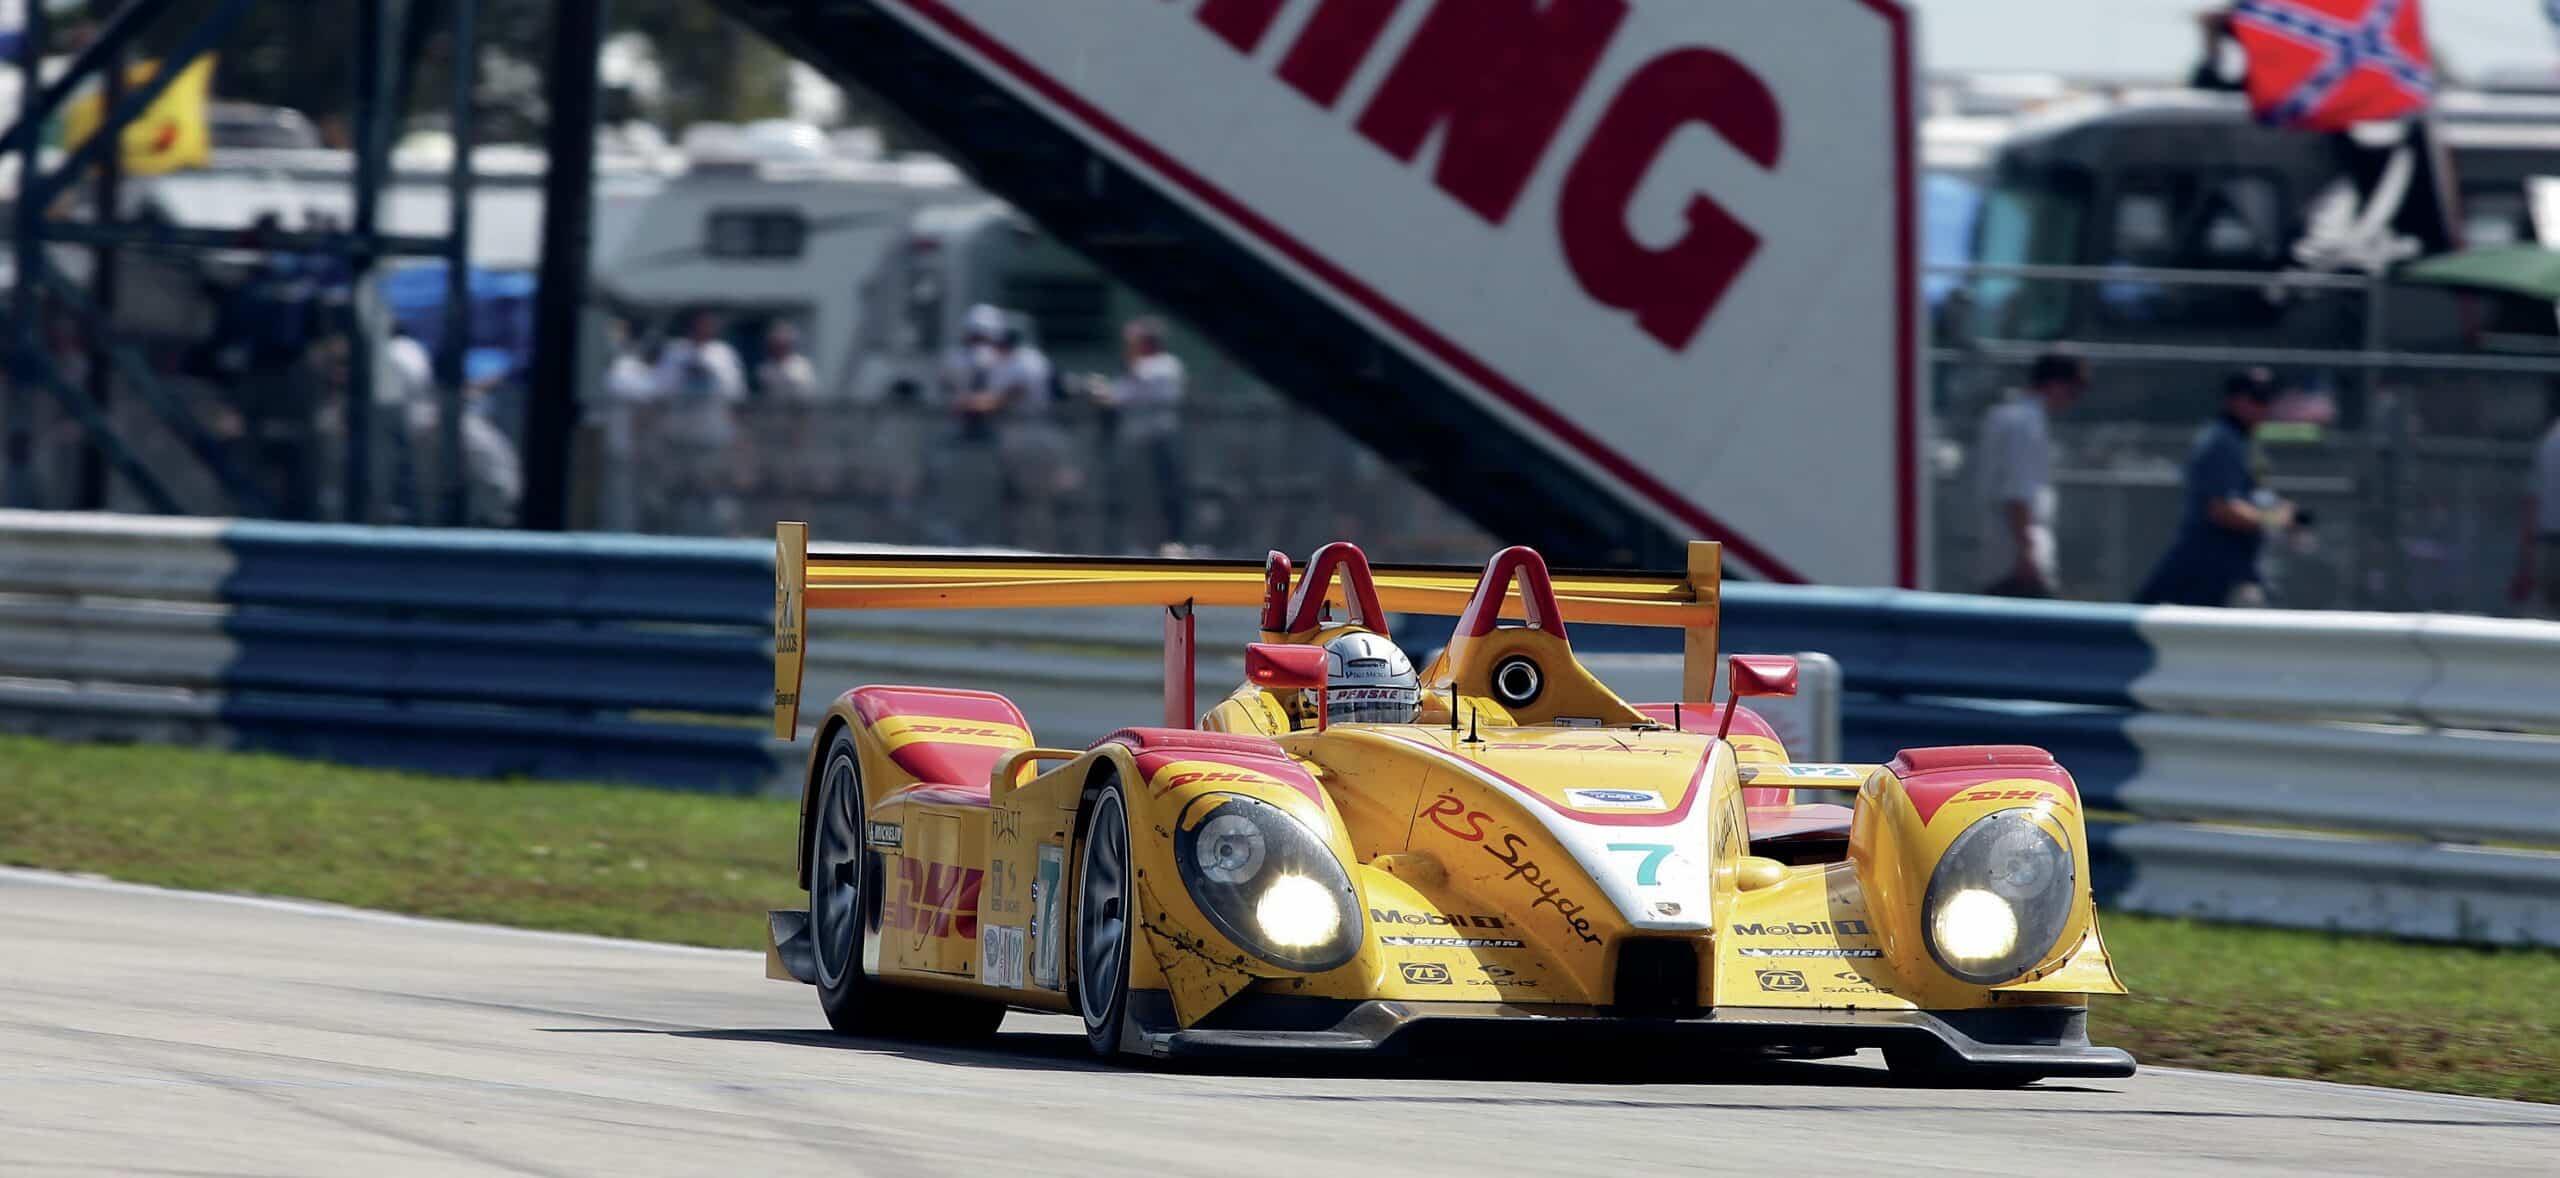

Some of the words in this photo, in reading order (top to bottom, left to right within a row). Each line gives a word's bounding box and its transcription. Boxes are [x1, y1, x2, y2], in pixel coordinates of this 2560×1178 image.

[1336, 690, 1398, 700] PENSKE
[1788, 766, 1851, 776] P2
[1168, 772, 1265, 790] DHL
[1419, 795, 1495, 841] RS
[1483, 833, 1602, 945] Spyder
[1606, 843, 1675, 885] 7
[1370, 908, 1467, 928] Mobil
[1732, 921, 1832, 936] Mobil
[1412, 938, 1521, 948] MICHELIN
[1770, 949, 1879, 958] MICHELIN
[1465, 979, 1539, 987] SACHS
